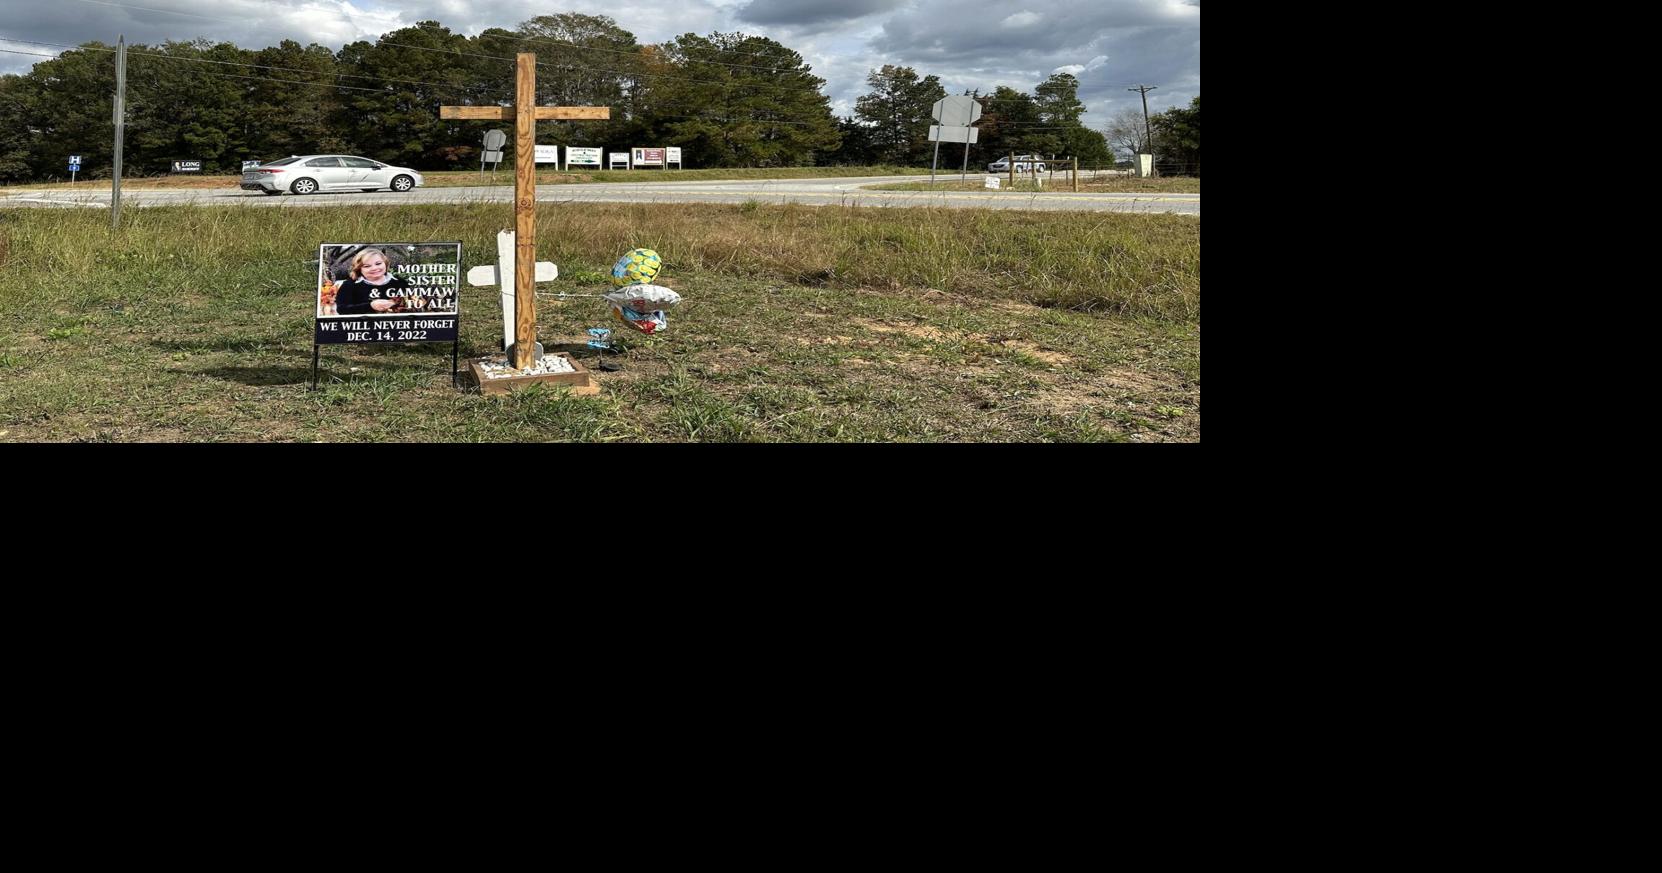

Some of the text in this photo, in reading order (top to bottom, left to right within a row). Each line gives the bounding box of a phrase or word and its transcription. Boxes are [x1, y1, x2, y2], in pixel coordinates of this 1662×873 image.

[71, 155, 80, 164] H
[397, 263, 456, 274] MOTHER
[408, 275, 455, 286] SISTER
[369, 286, 455, 298] & GAMMAW
[406, 298, 455, 309] TO ALL
[320, 319, 455, 331] WE WILL NEVER FORGET
[347, 330, 427, 341] DEC. 14, 2022
